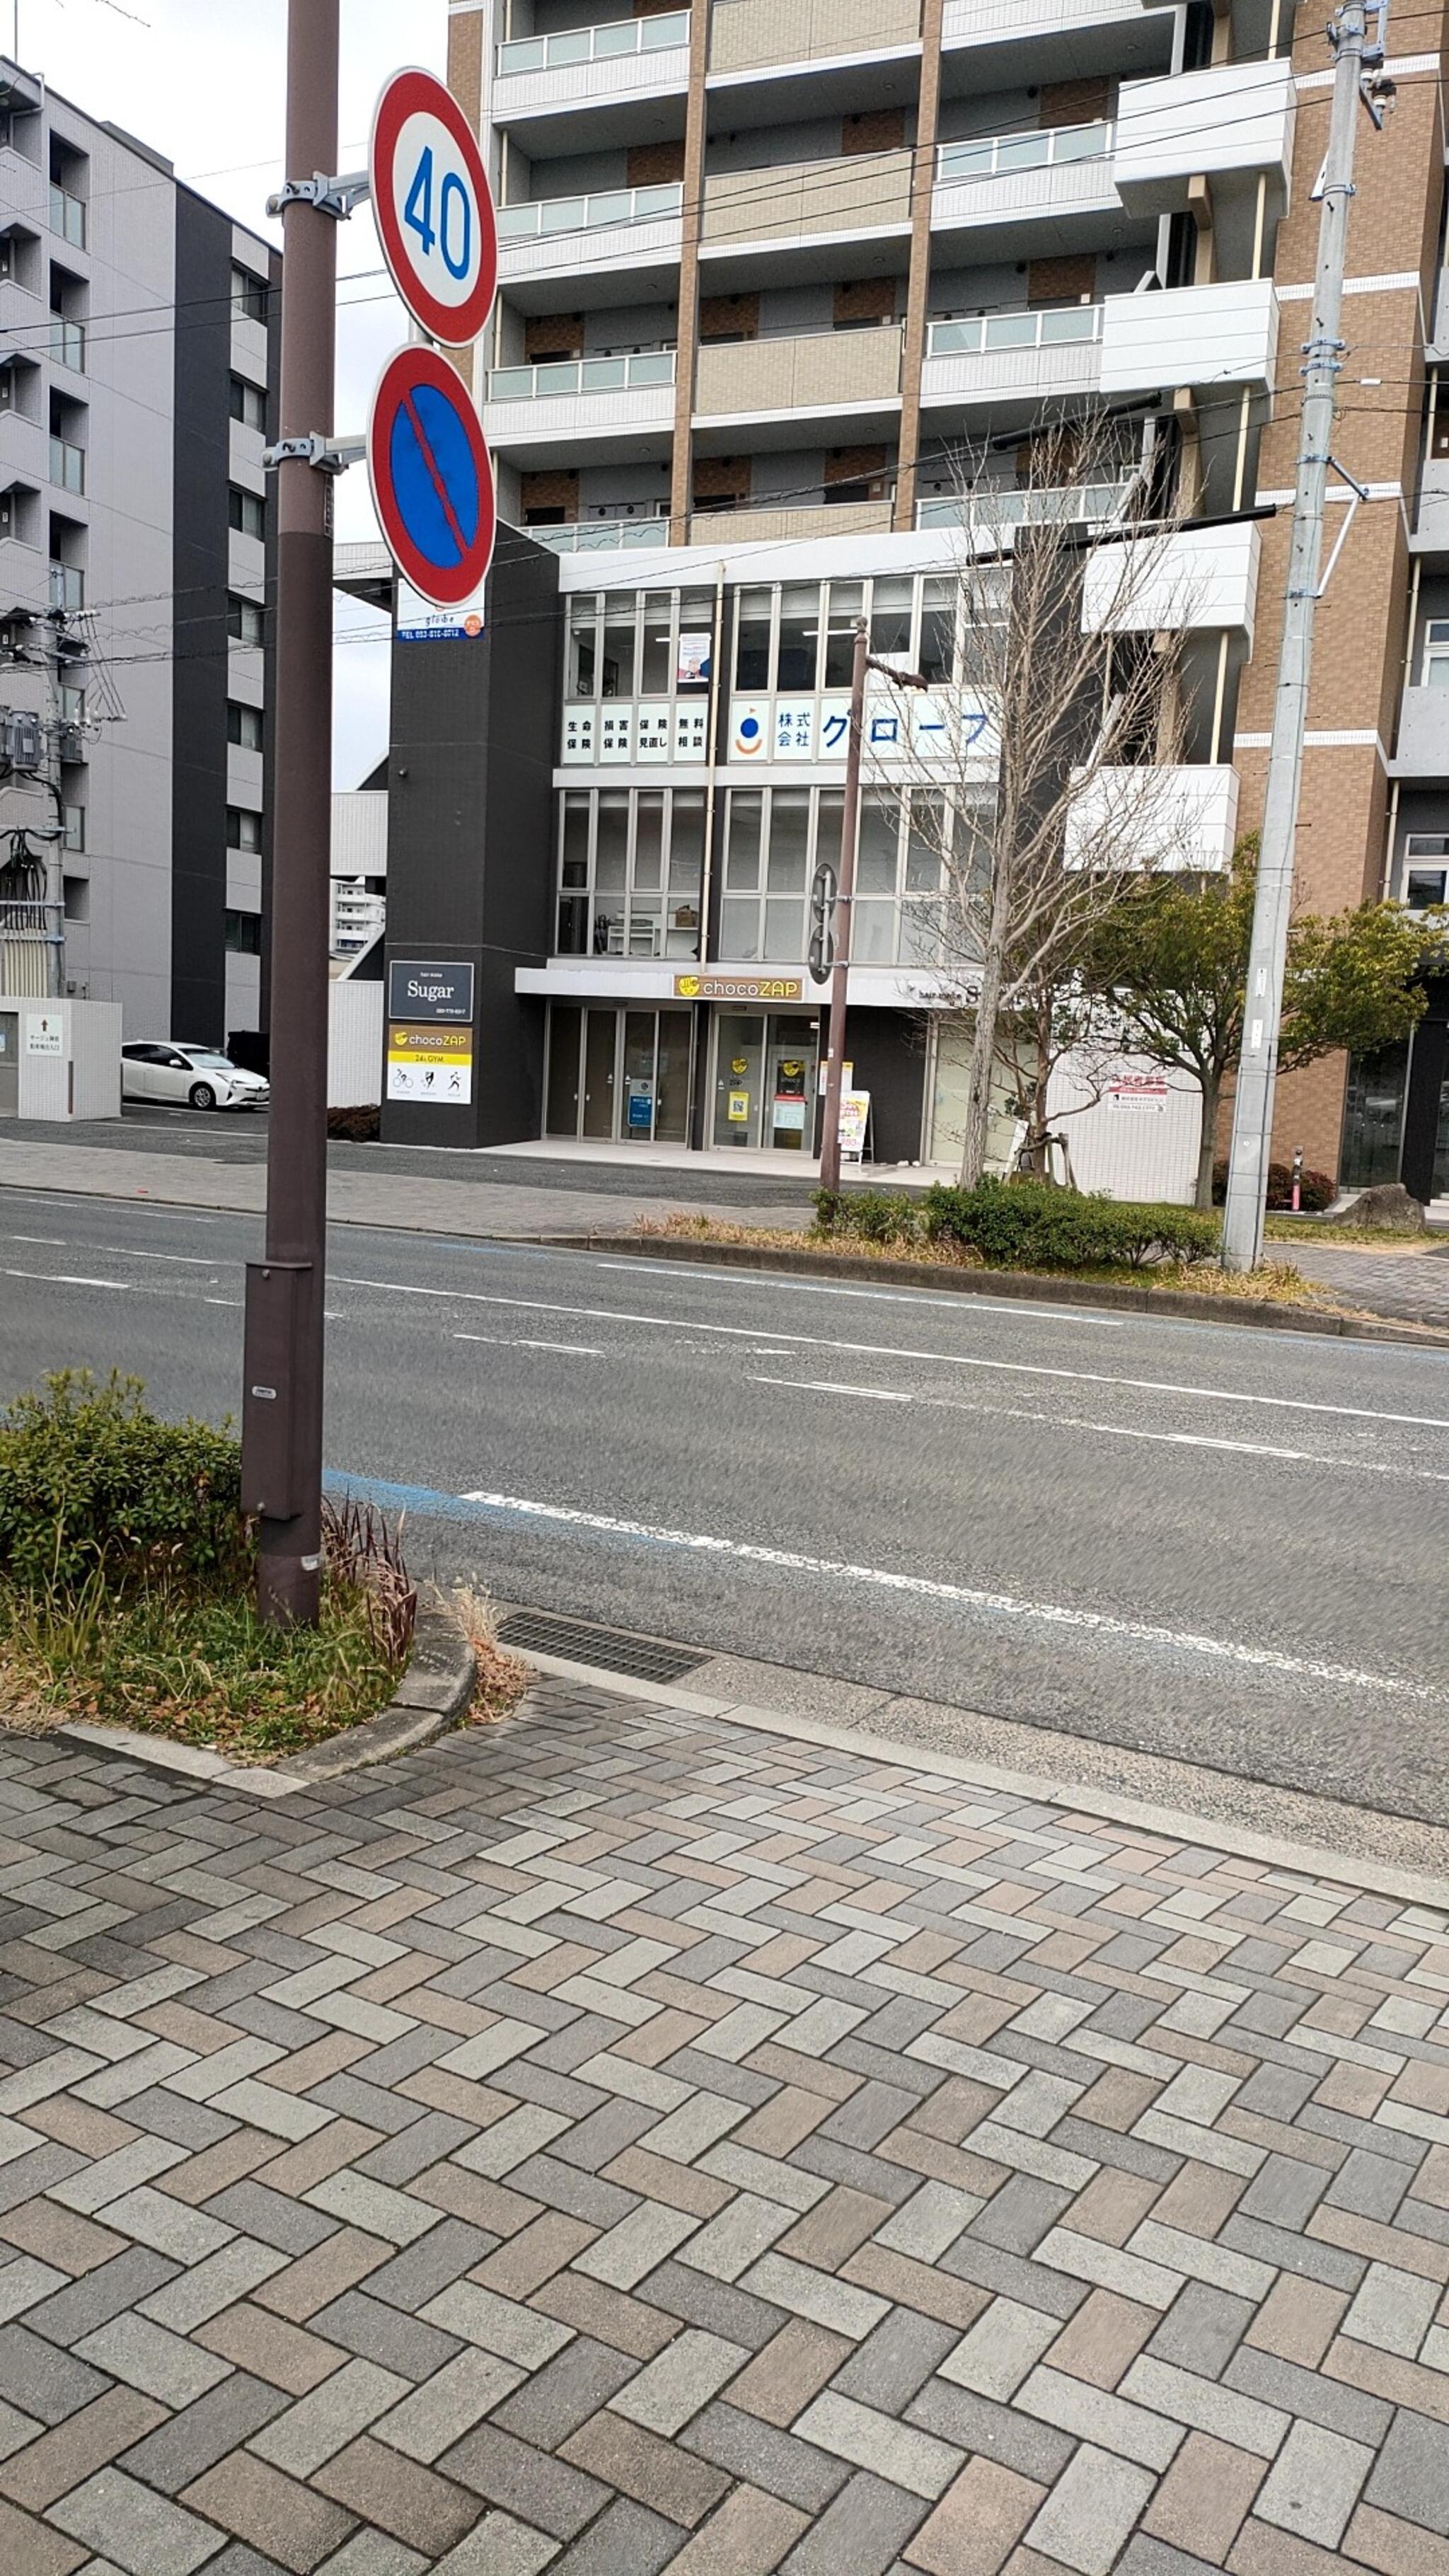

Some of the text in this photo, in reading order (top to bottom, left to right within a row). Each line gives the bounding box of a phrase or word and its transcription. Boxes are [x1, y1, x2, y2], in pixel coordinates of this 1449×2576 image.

[405, 146, 471, 280] 40
[402, 631, 414, 640] TEL
[604, 720, 628, 731] 損害
[640, 718, 667, 729] 保険
[679, 718, 703, 729] 無料
[778, 712, 812, 727] 株式
[568, 720, 591, 732] 生命
[567, 738, 591, 749] 保険
[604, 737, 628, 749] 保険
[640, 737, 667, 749] 見直し
[679, 736, 703, 748] 相談
[778, 731, 810, 747] 会社
[407, 980, 454, 1002] Sugar
[703, 979, 798, 998] chocoZAP
[409, 1034, 466, 1046] chocoZAP
